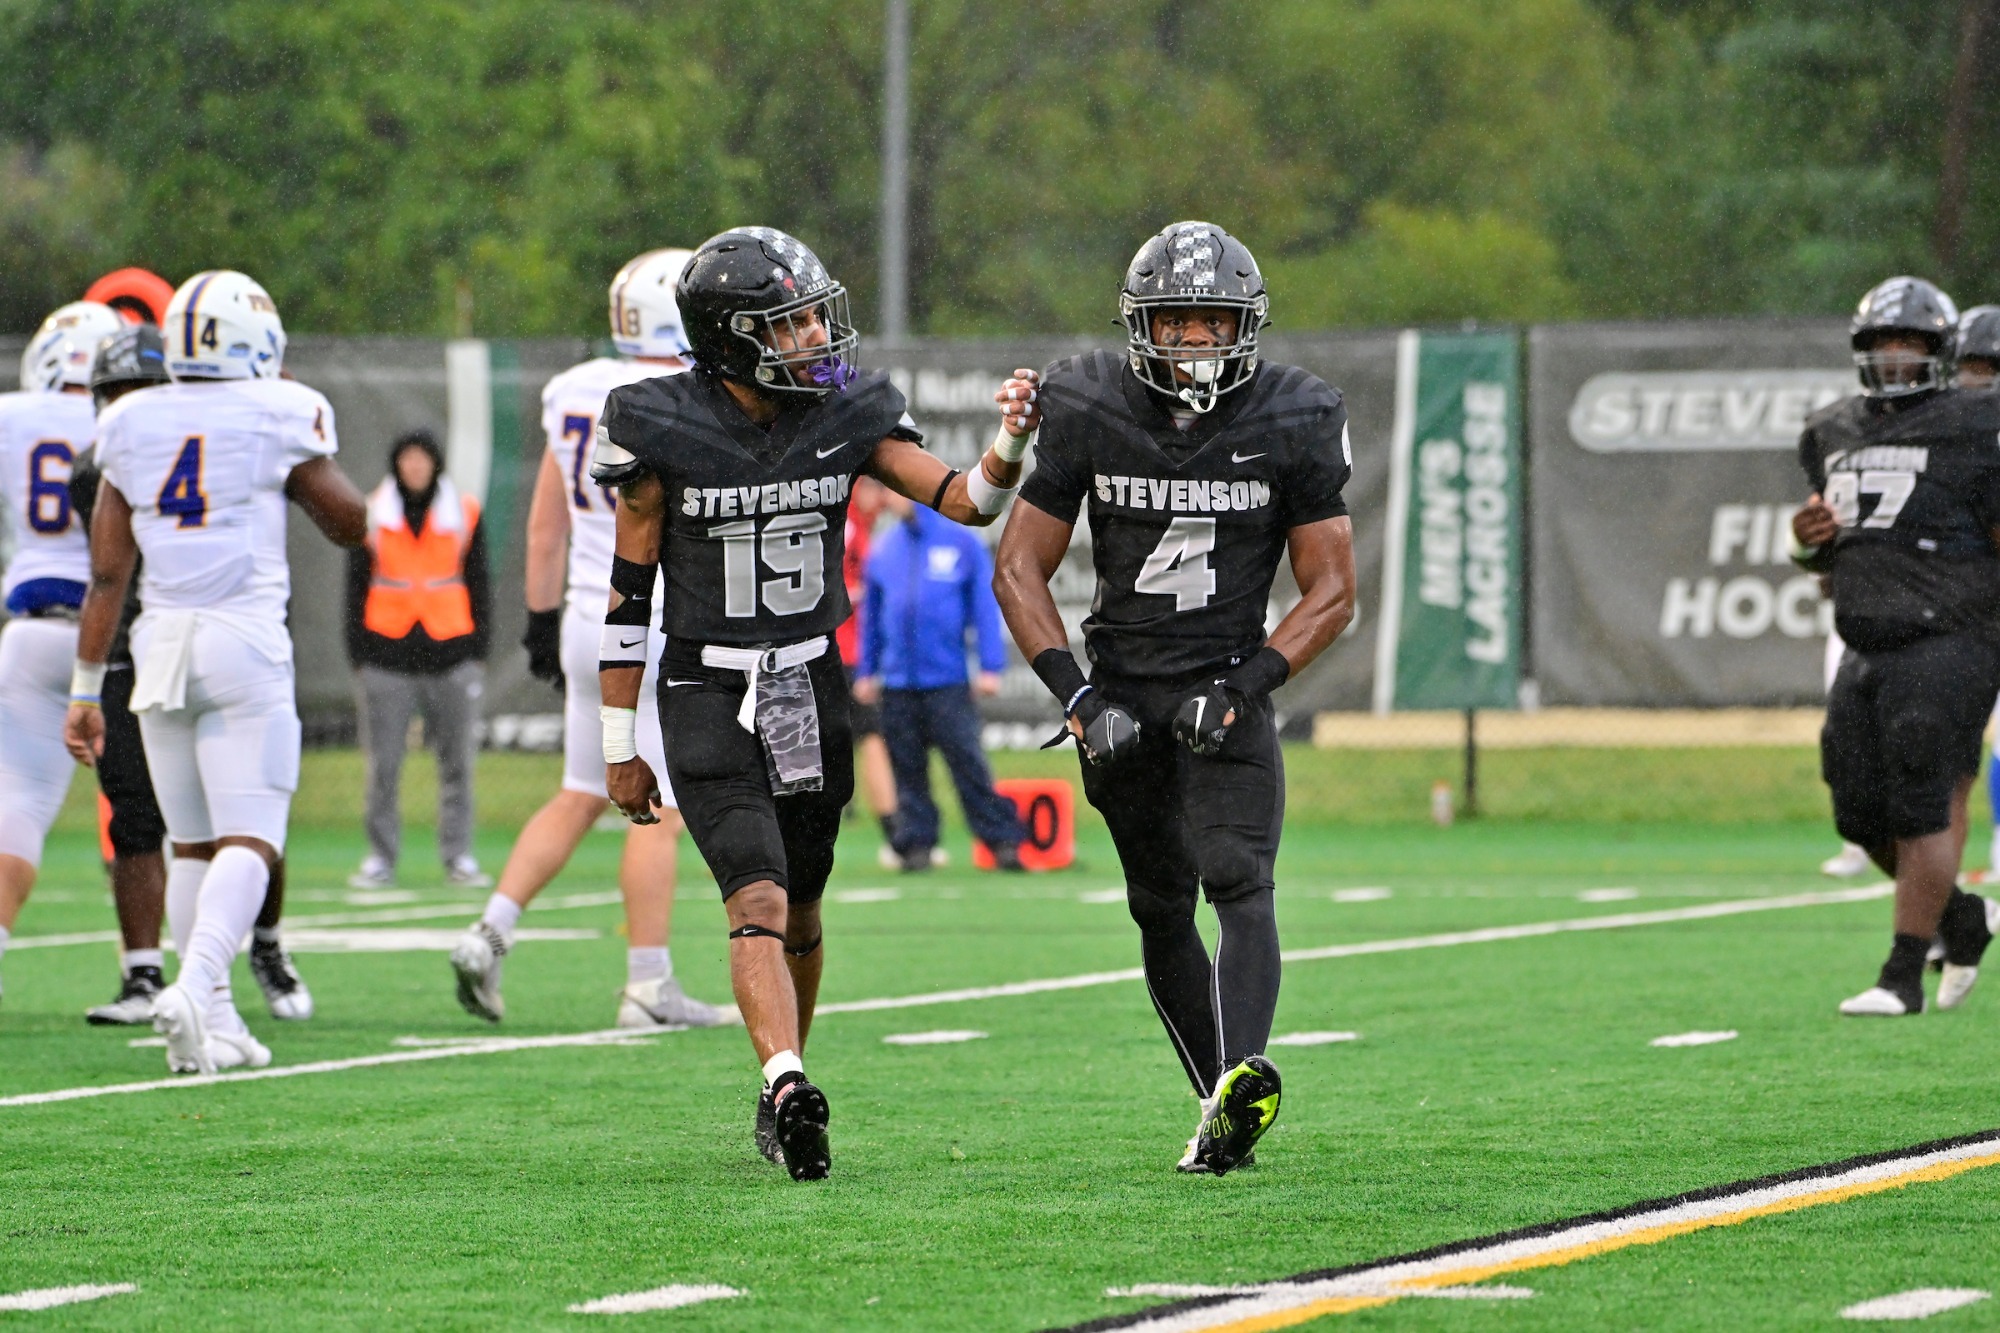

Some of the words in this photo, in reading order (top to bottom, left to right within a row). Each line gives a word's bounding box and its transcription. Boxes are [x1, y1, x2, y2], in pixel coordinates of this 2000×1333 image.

[200, 317, 218, 351] 4
[28, 439, 74, 536] 6
[156, 434, 209, 530] 4
[682, 473, 852, 518] STEVENSON
[1094, 473, 1271, 512] STEVENSON
[1419, 438, 1463, 609] MEN'S
[1463, 380, 1509, 664] LACROSSE
[707, 512, 829, 618] 19
[1135, 516, 1217, 612] 4
[1659, 574, 1836, 639] HOC
